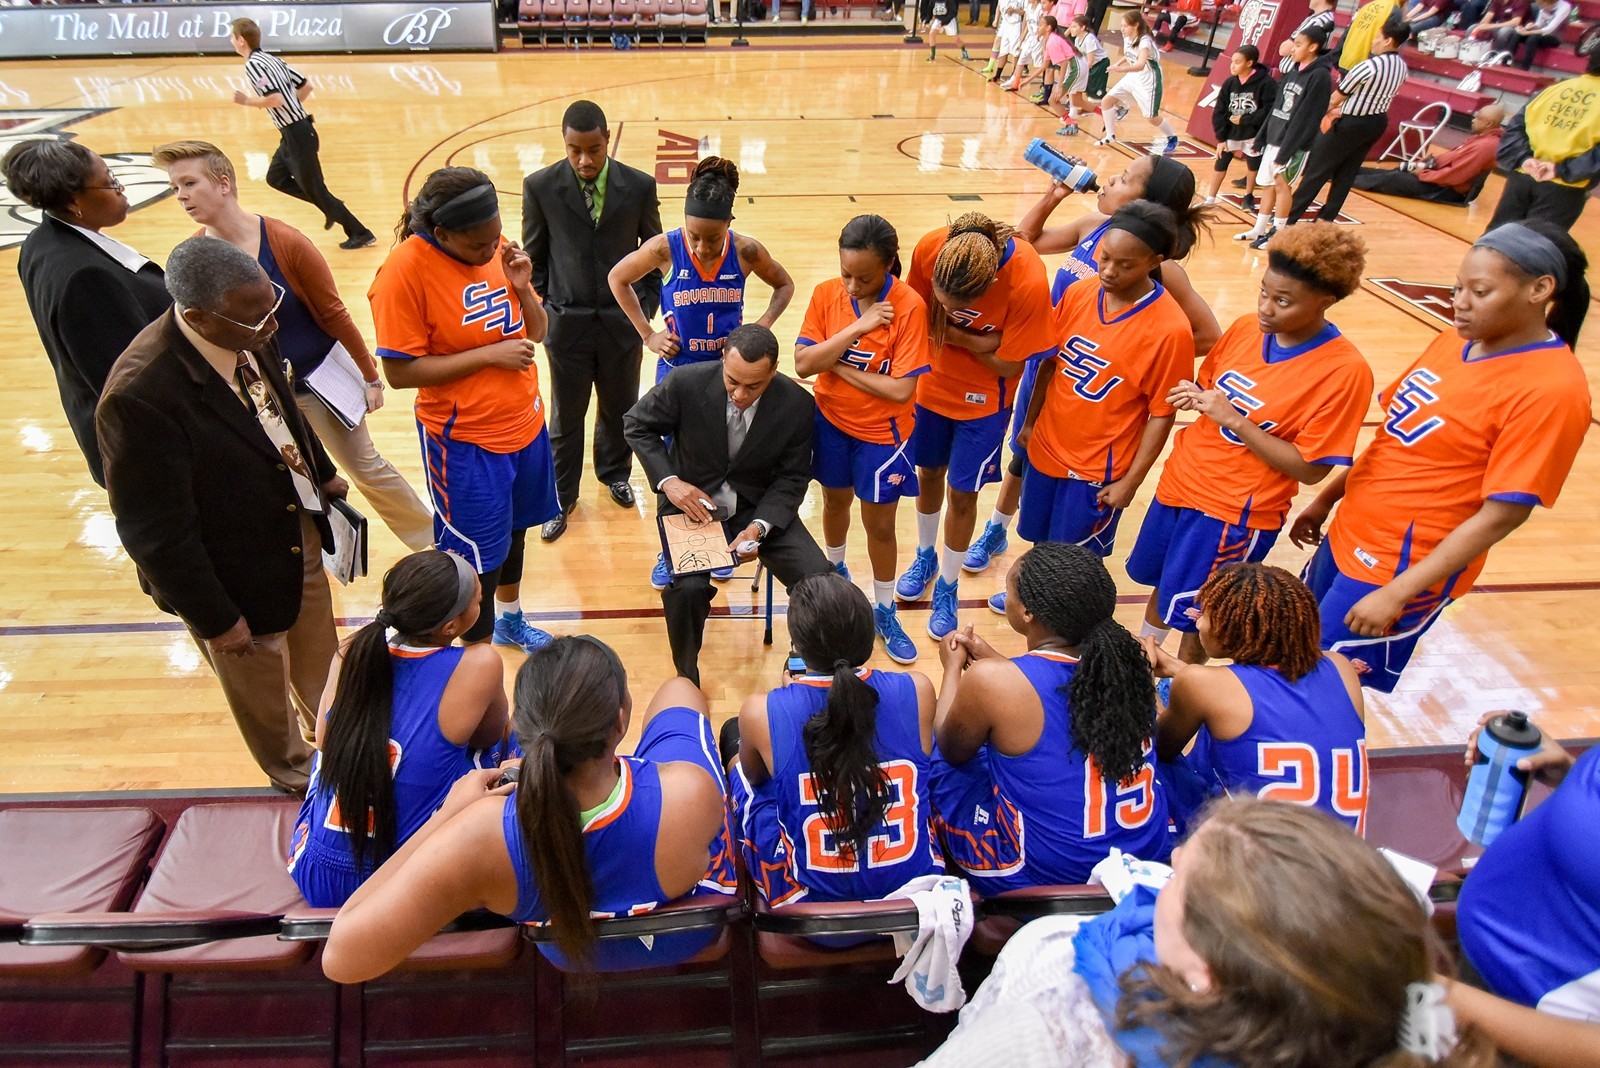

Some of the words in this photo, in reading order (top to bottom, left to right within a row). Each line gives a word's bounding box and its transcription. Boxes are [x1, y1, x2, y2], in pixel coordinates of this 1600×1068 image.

[51, 13, 99, 40] The
[107, 12, 169, 39] Mall
[179, 14, 203, 38] at
[268, 9, 343, 37] Plaza
[383, 7, 459, 45] BP
[1560, 87, 1597, 106] CSC
[1543, 114, 1580, 131] STAFF
[1550, 101, 1588, 120] EVENT
[673, 287, 741, 307] SAVANNAH
[707, 313, 713, 334] 1
[689, 337, 728, 351] STAT
[1058, 335, 1125, 402] SSU
[1083, 738, 1155, 839] 15
[1257, 739, 1370, 840] 24
[798, 759, 919, 873] 23
